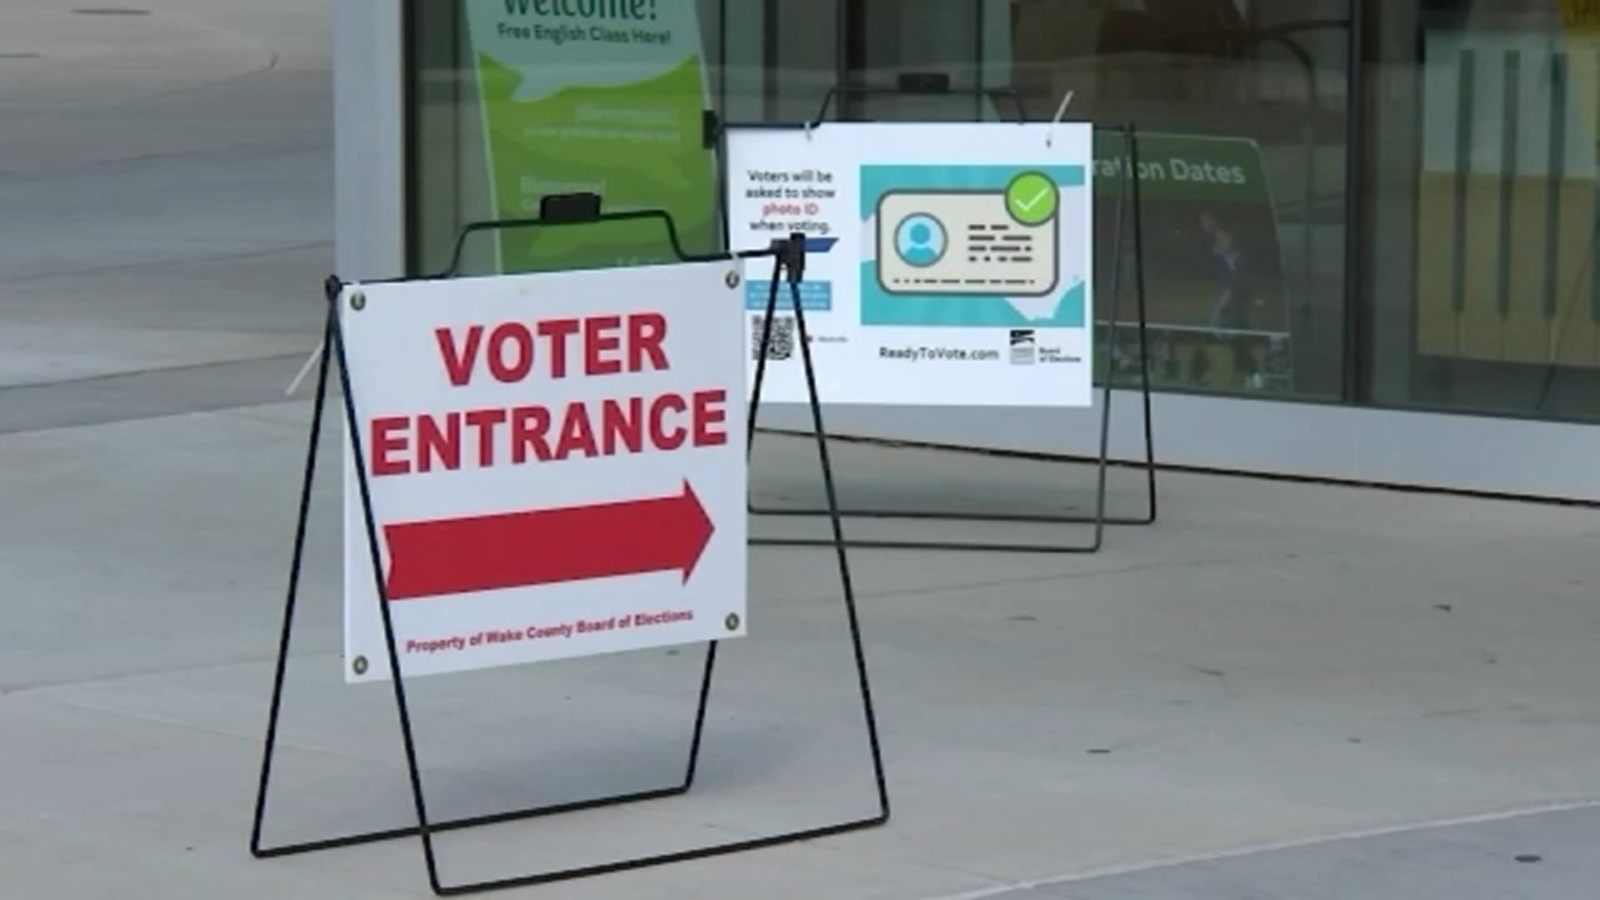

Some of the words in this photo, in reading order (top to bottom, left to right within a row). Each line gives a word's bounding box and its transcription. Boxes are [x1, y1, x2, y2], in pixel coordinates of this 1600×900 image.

[498, 22, 530, 40] Free
[534, 24, 586, 45] English
[590, 26, 629, 43] Class
[632, 28, 671, 45] Here!
[747, 170, 788, 182] Voters
[792, 170, 813, 182] will
[817, 170, 832, 182] be
[1169, 158, 1246, 184] Dates
[746, 186, 782, 198] asked
[785, 187, 799, 198] to
[802, 186, 835, 198] show
[763, 203, 801, 217] photo
[804, 203, 819, 215] ID
[750, 220, 784, 231] when
[434, 312, 670, 387] VOTER
[879, 346, 999, 362] ReadyToVote.com
[370, 389, 728, 477] ENTRANCE
[406, 636, 465, 653] Property
[469, 632, 483, 646] of
[486, 630, 522, 644] Wake
[526, 622, 573, 638] County
[577, 618, 615, 633] Board
[618, 615, 632, 628] of
[635, 610, 694, 626] Elections
